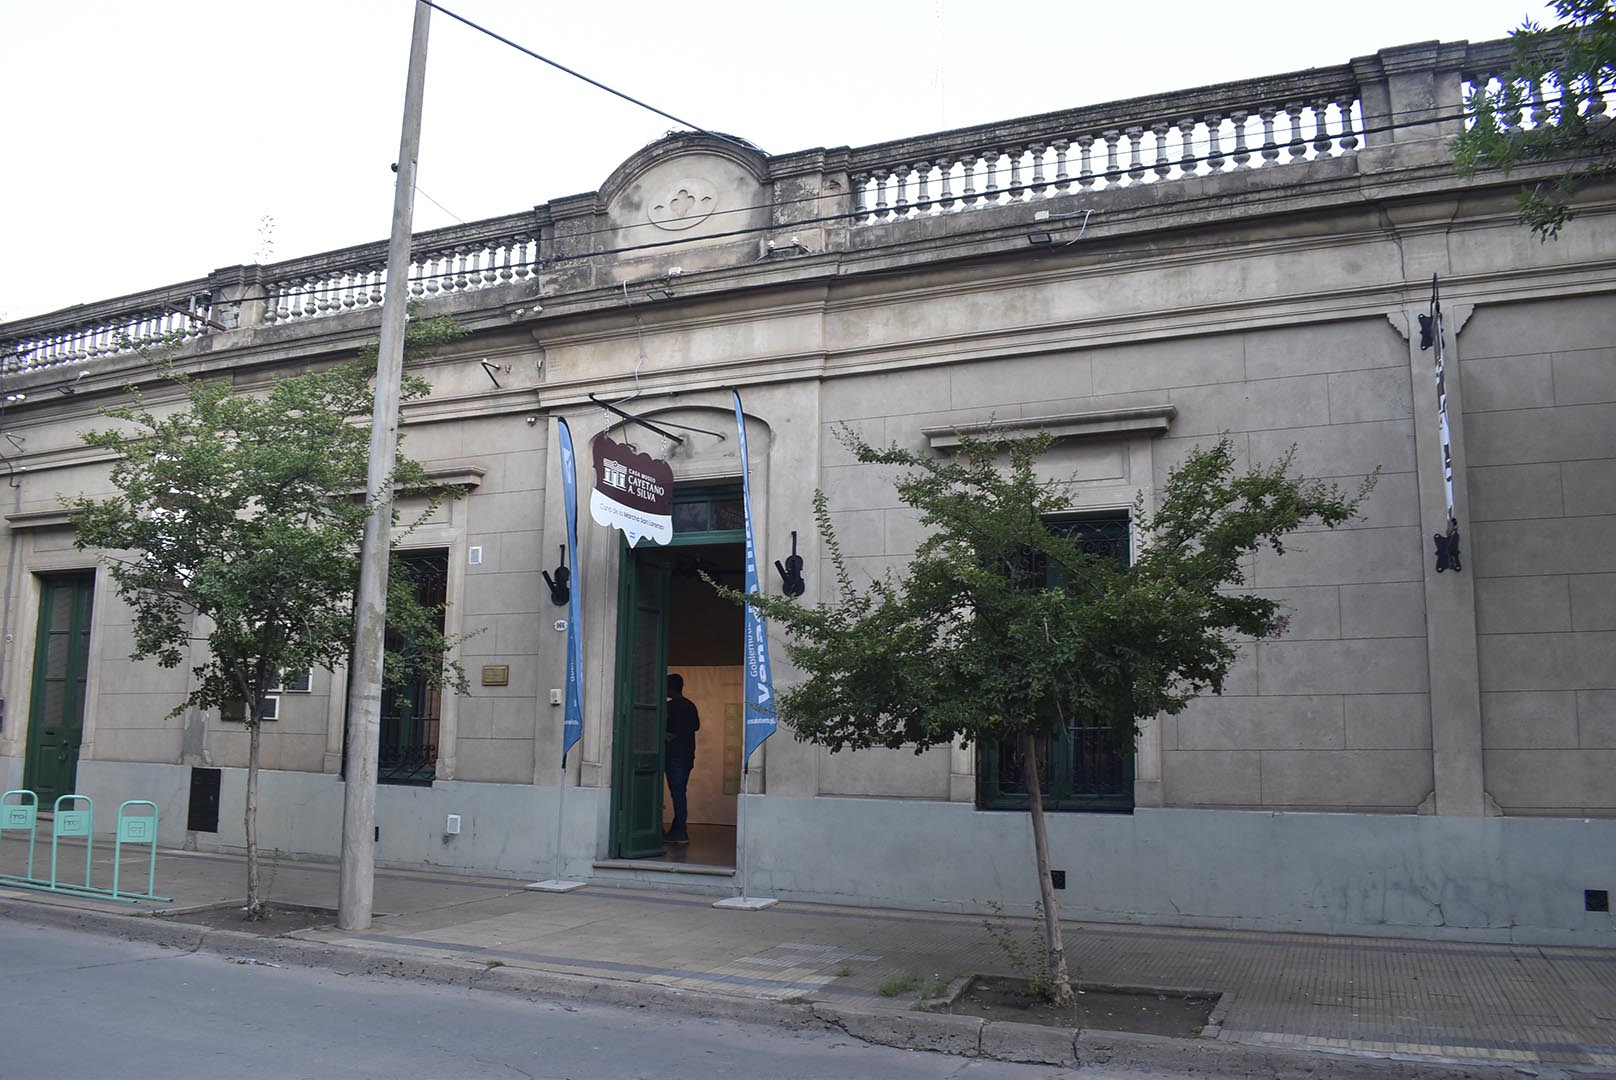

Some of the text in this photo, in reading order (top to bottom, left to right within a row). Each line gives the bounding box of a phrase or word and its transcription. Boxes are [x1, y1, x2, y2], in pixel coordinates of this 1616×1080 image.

[628, 468, 641, 477] CASA
[628, 475, 665, 496] CAYETANO
[628, 485, 656, 502] A. SILVA
[747, 635, 758, 677] Gobierno
